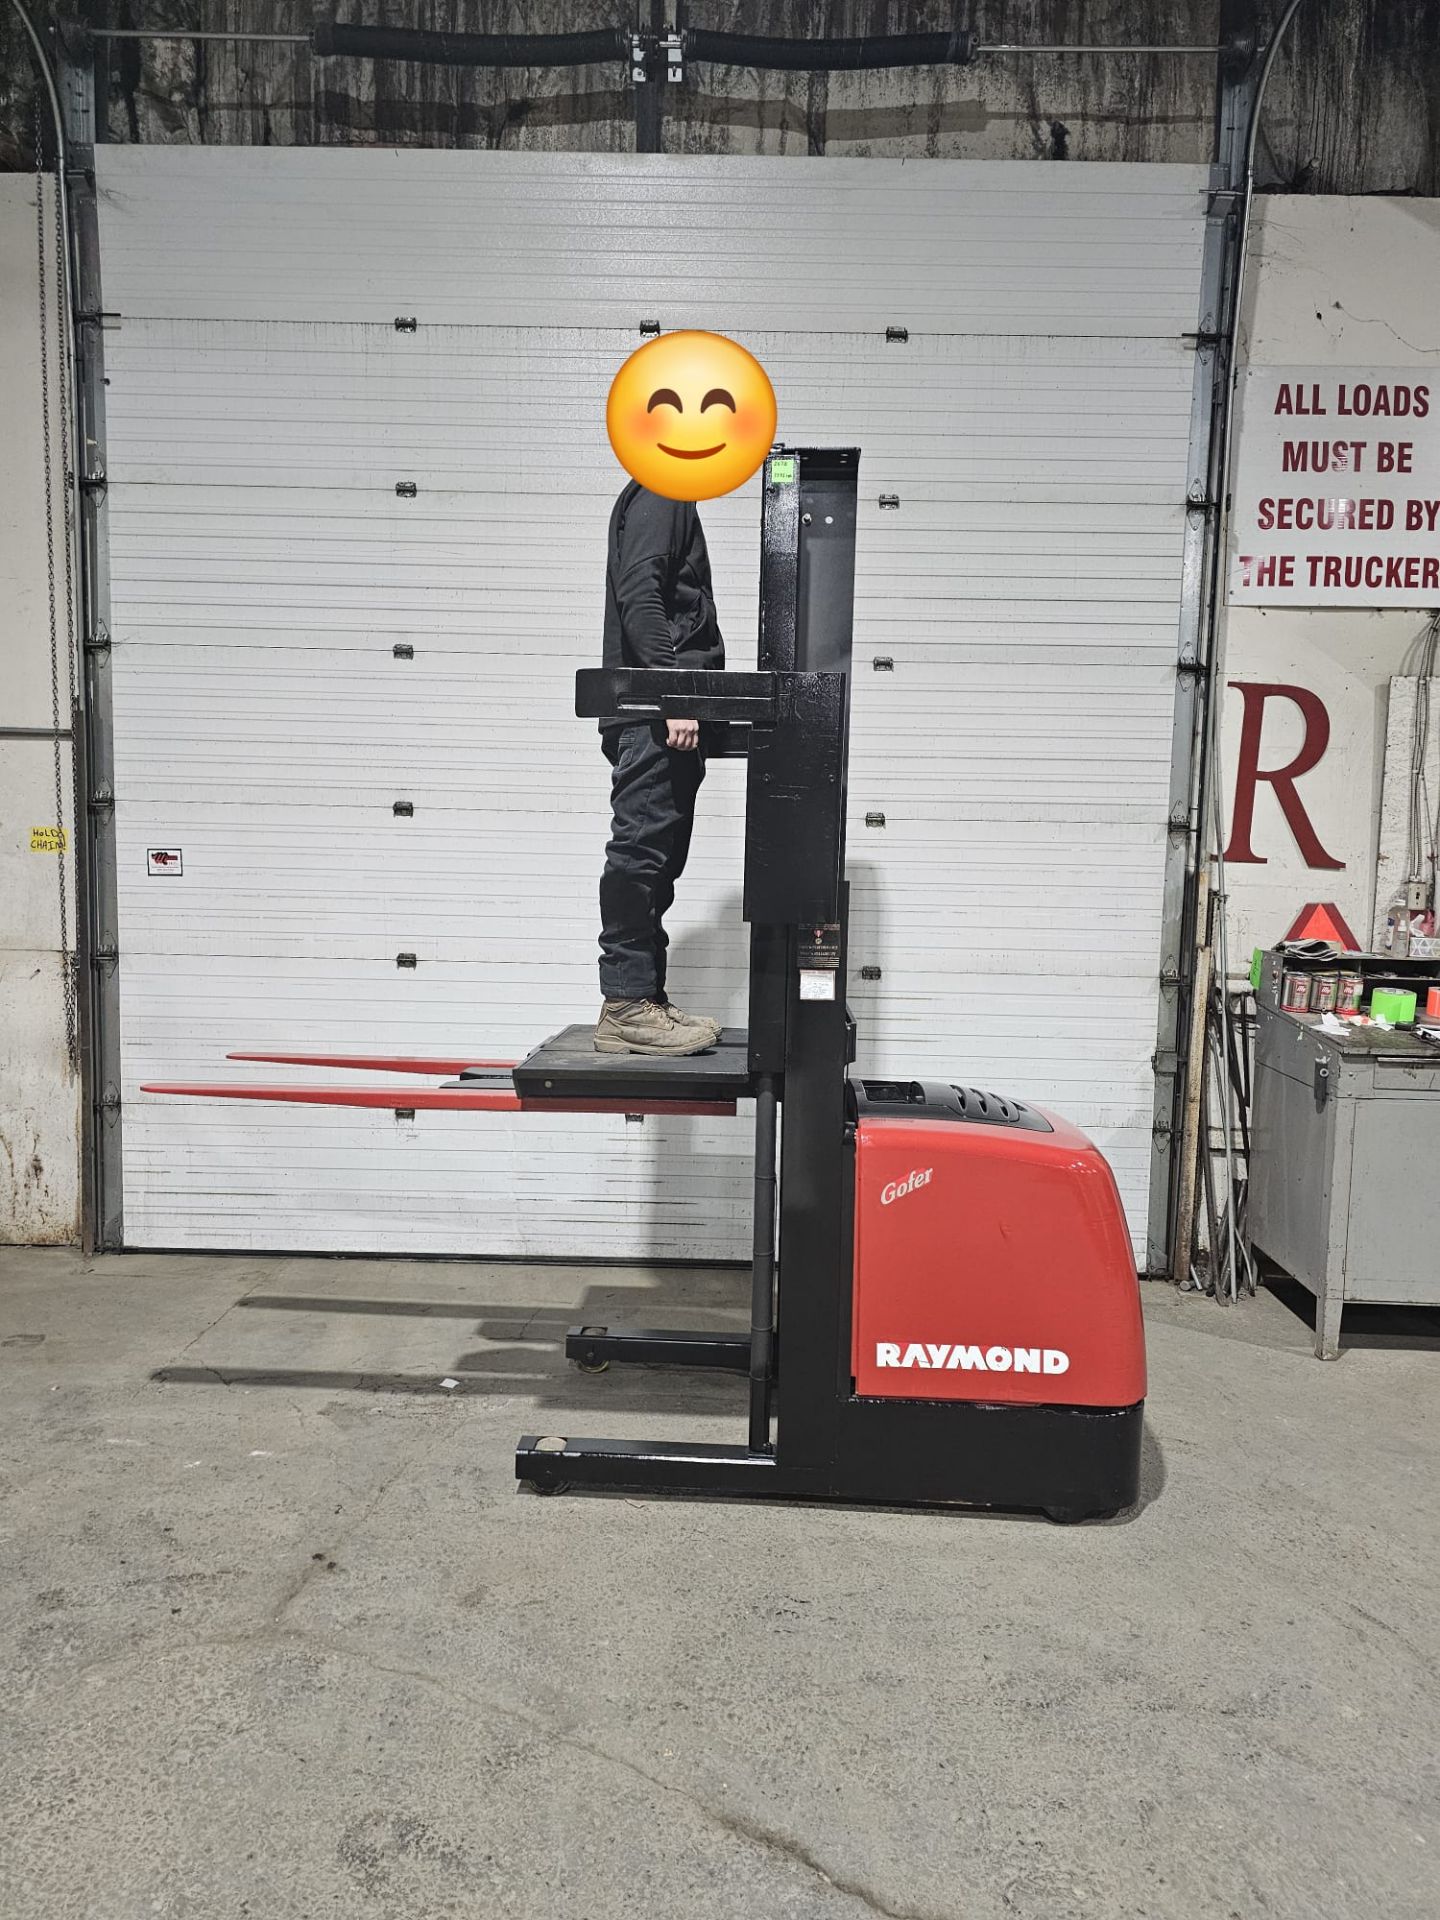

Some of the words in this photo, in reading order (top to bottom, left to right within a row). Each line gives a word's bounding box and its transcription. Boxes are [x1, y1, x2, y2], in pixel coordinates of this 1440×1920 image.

[1274, 384, 1326, 415] ALL
[1338, 384, 1429, 417] LOADS
[1282, 441, 1366, 472] MUST
[1377, 442, 1413, 473] BE
[1257, 498, 1394, 530] SECURED
[1405, 500, 1440, 531] BY
[1239, 556, 1295, 587] THE
[1306, 556, 1440, 589] TRUCKER
[1210, 681, 1346, 869] R
[880, 1167, 933, 1205] Gofer
[876, 1342, 1070, 1375] RAYMOND
